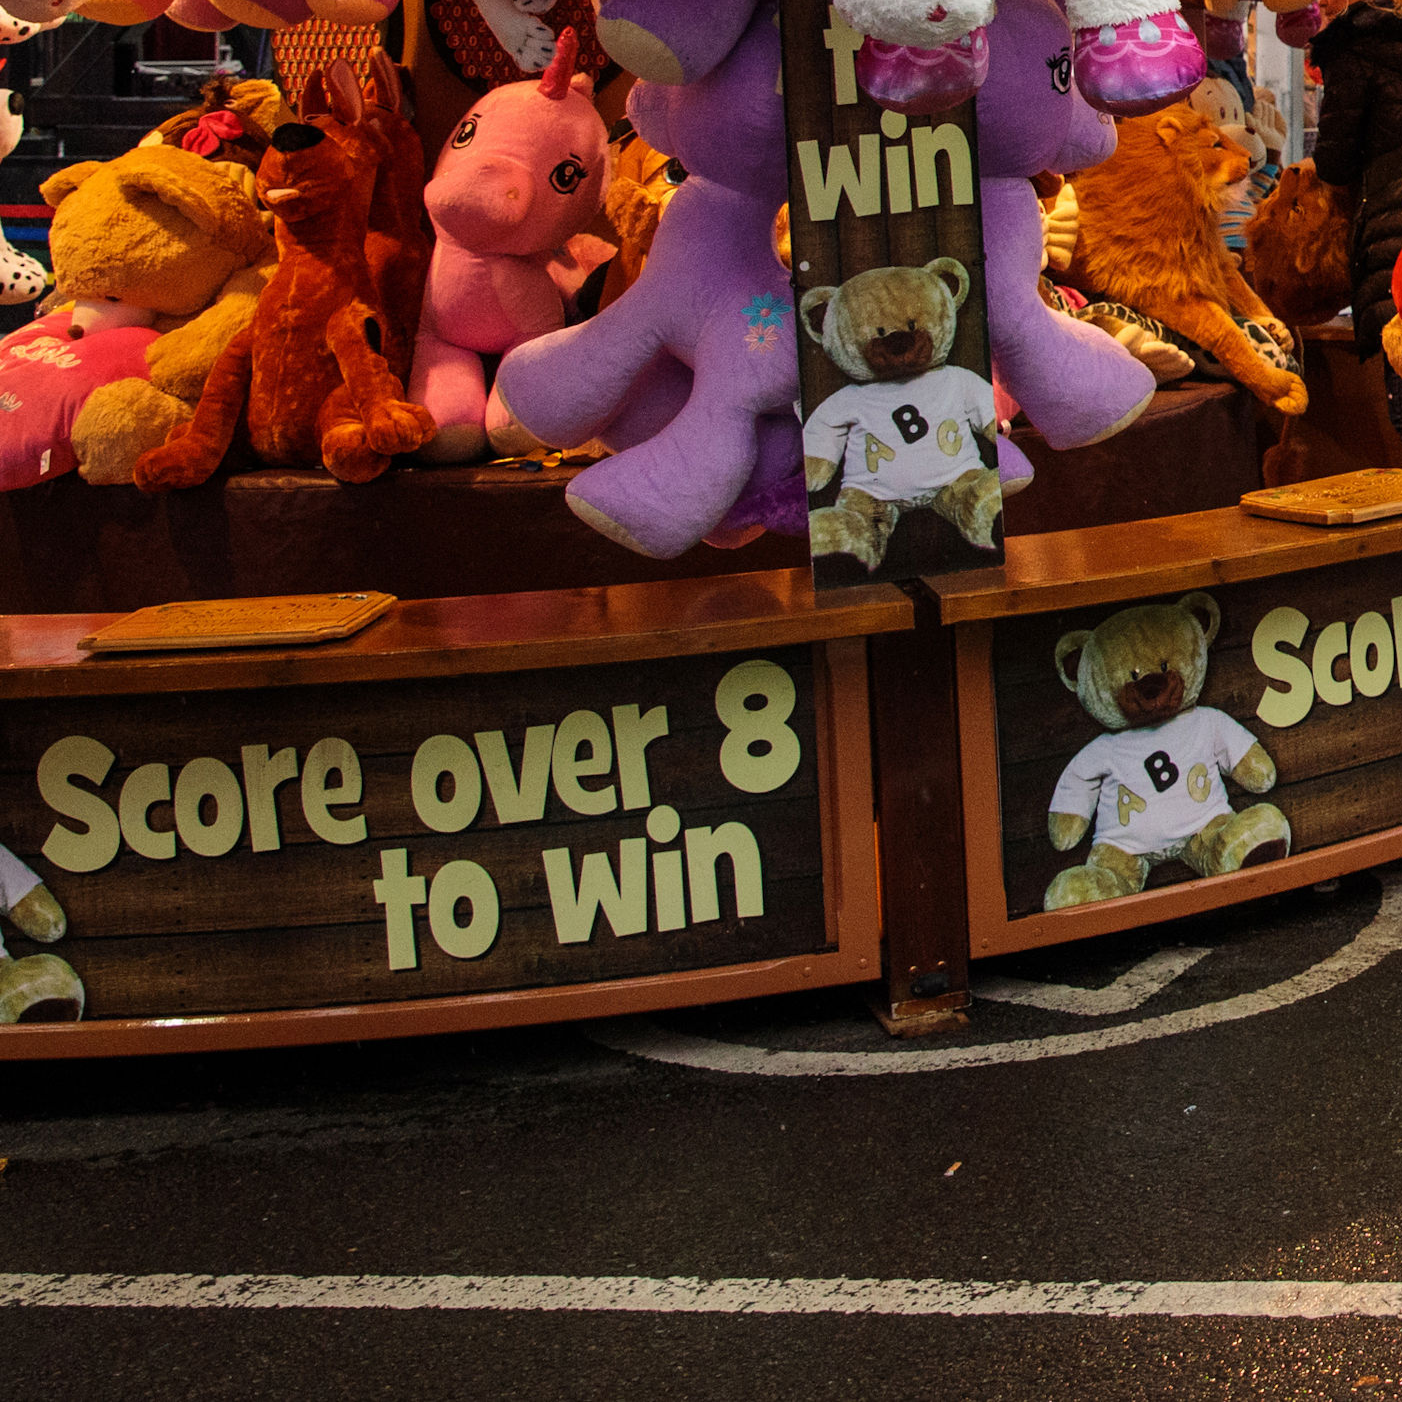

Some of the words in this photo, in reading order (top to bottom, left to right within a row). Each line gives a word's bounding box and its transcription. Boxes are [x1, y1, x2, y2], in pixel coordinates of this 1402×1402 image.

[823, 4, 865, 106] t
[797, 109, 974, 223] win
[36, 735, 369, 874] Score
[410, 703, 669, 833] over
[714, 658, 802, 795] 8
[372, 848, 501, 971] to
[541, 804, 765, 945] win
